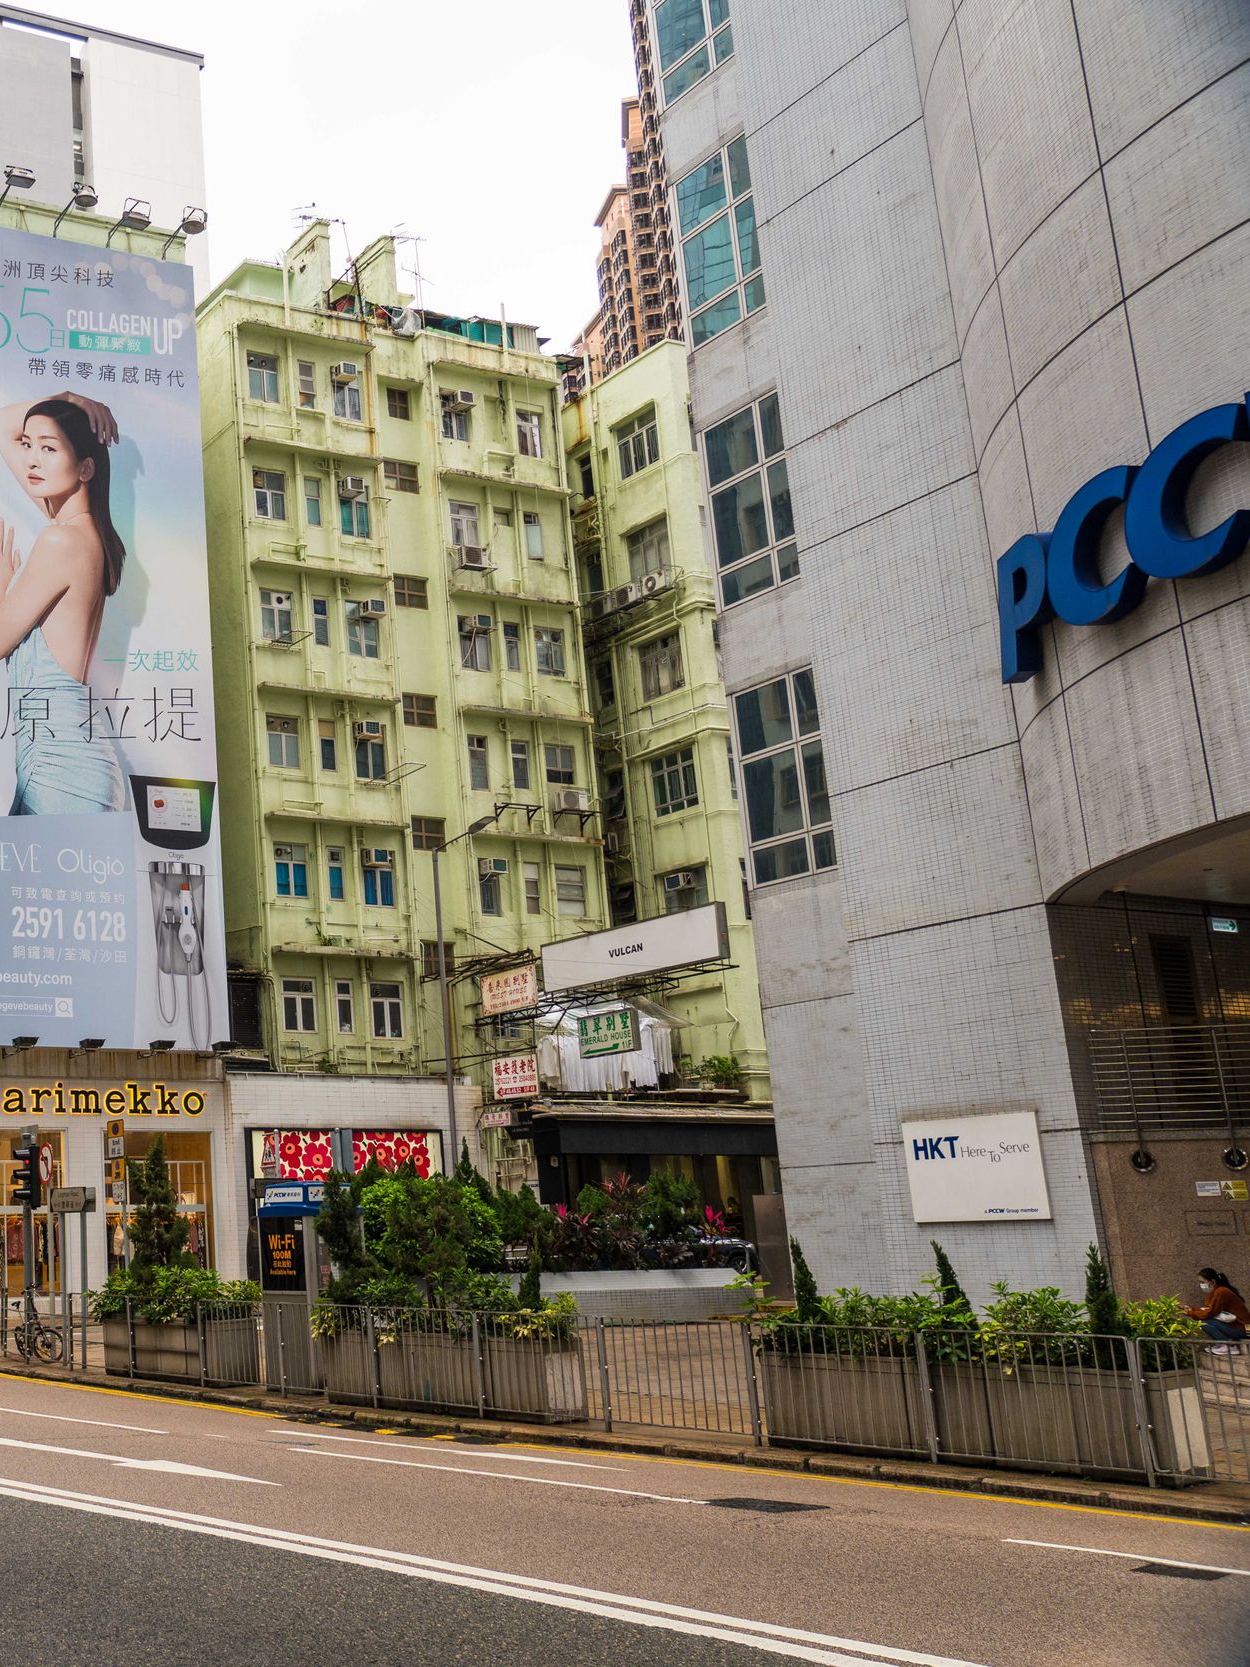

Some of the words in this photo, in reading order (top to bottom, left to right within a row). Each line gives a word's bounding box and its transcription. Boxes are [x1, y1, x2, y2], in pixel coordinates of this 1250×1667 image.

[66, 309, 151, 337] COLLAGEN
[153, 318, 183, 355] UP
[28, 357, 186, 389] 帶領零痛感時代
[997, 389, 1250, 685] PCC
[103, 648, 199, 672] 一次起效
[57, 848, 125, 884] Oligio
[11, 886, 125, 905] 可致電查詢或預約
[12, 906, 63, 940] 2591
[73, 909, 126, 943] 6128
[608, 942, 643, 958] VULCAN
[580, 1011, 630, 1037] 翡翠別墅
[581, 1034, 608, 1046] EMERALD
[610, 1029, 632, 1040] HOUSE
[913, 1136, 959, 1160] HKT
[960, 1146, 987, 1158] Here
[988, 1150, 1001, 1163] To
[999, 1142, 1030, 1154] Serve
[268, 1233, 295, 1250] Wi-Fi
[272, 1250, 292, 1260] 100M
